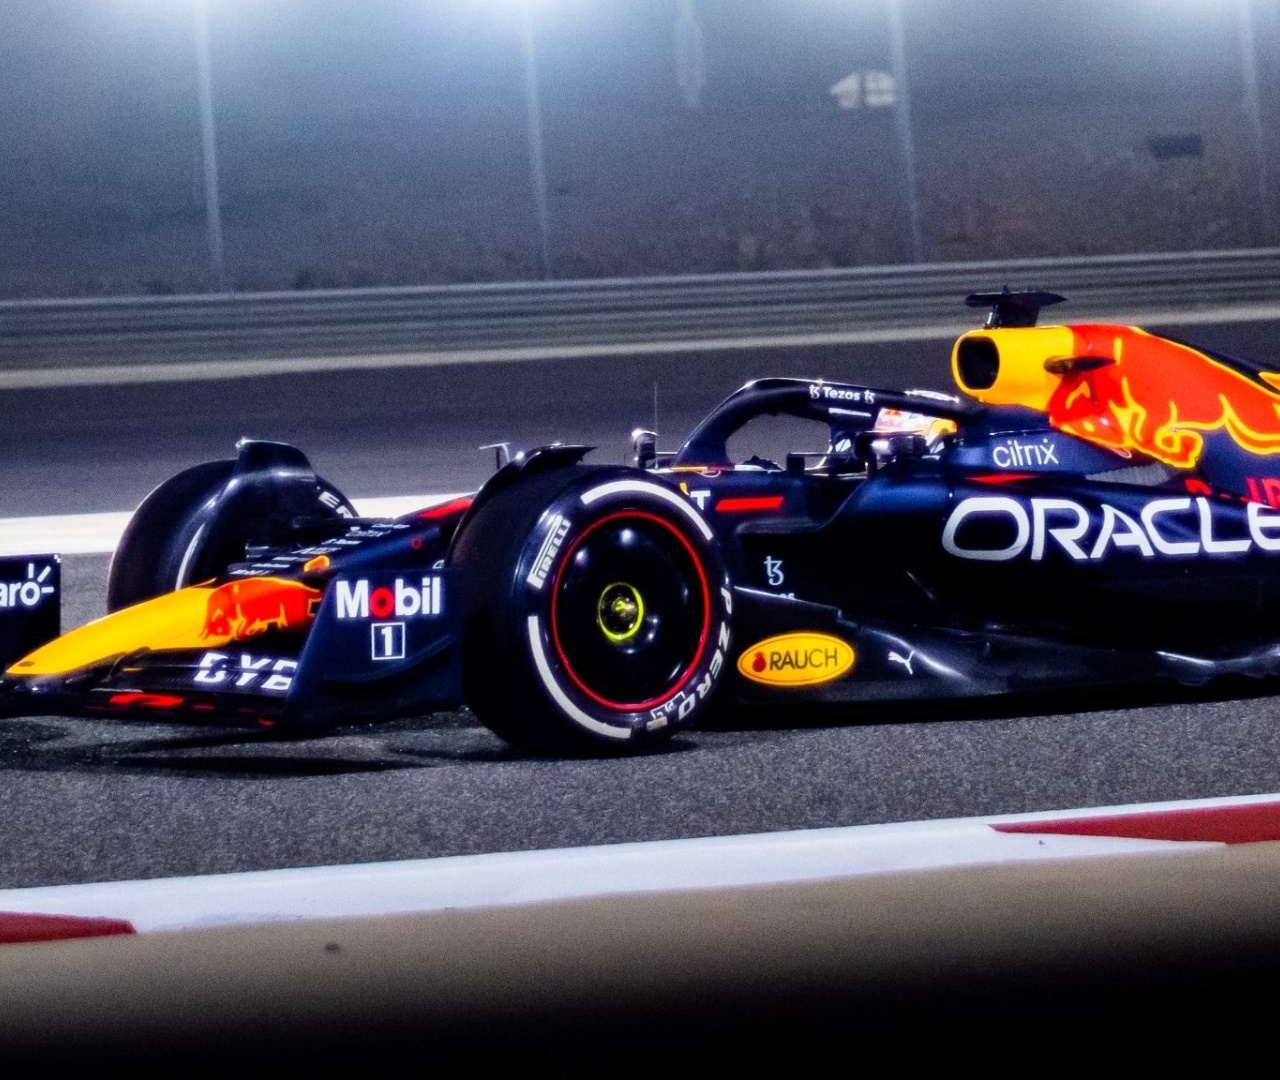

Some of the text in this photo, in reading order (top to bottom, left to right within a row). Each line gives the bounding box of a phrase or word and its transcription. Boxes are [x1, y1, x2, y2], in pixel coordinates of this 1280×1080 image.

[823, 387, 860, 401] Tezos
[993, 438, 1058, 468] citrix
[526, 515, 571, 590] PIRELLI
[336, 577, 441, 619] Mobil
[679, 622, 731, 720] ZERO
[769, 648, 838, 672] RAUCH
